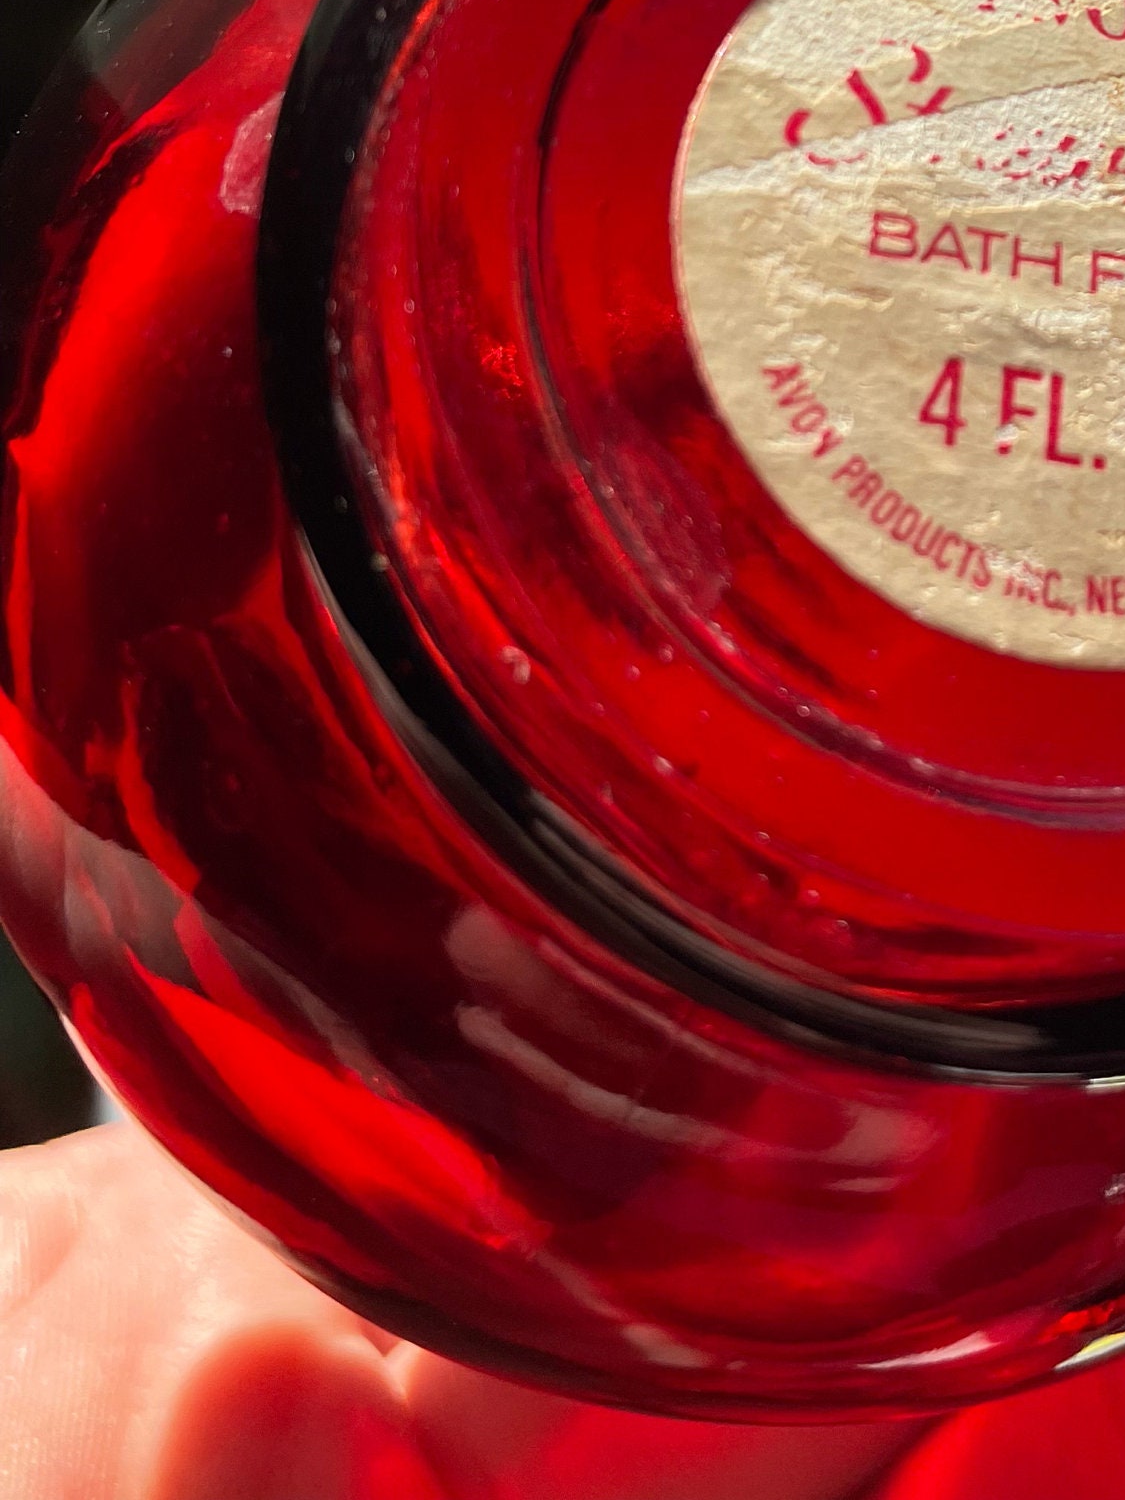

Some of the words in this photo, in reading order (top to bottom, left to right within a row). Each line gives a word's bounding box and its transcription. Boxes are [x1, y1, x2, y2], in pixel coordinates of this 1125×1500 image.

[868, 210, 1063, 288] BATH
[918, 357, 966, 446] 4
[996, 365, 1106, 469] FL.
[831, 454, 993, 588] PRODUCTS
